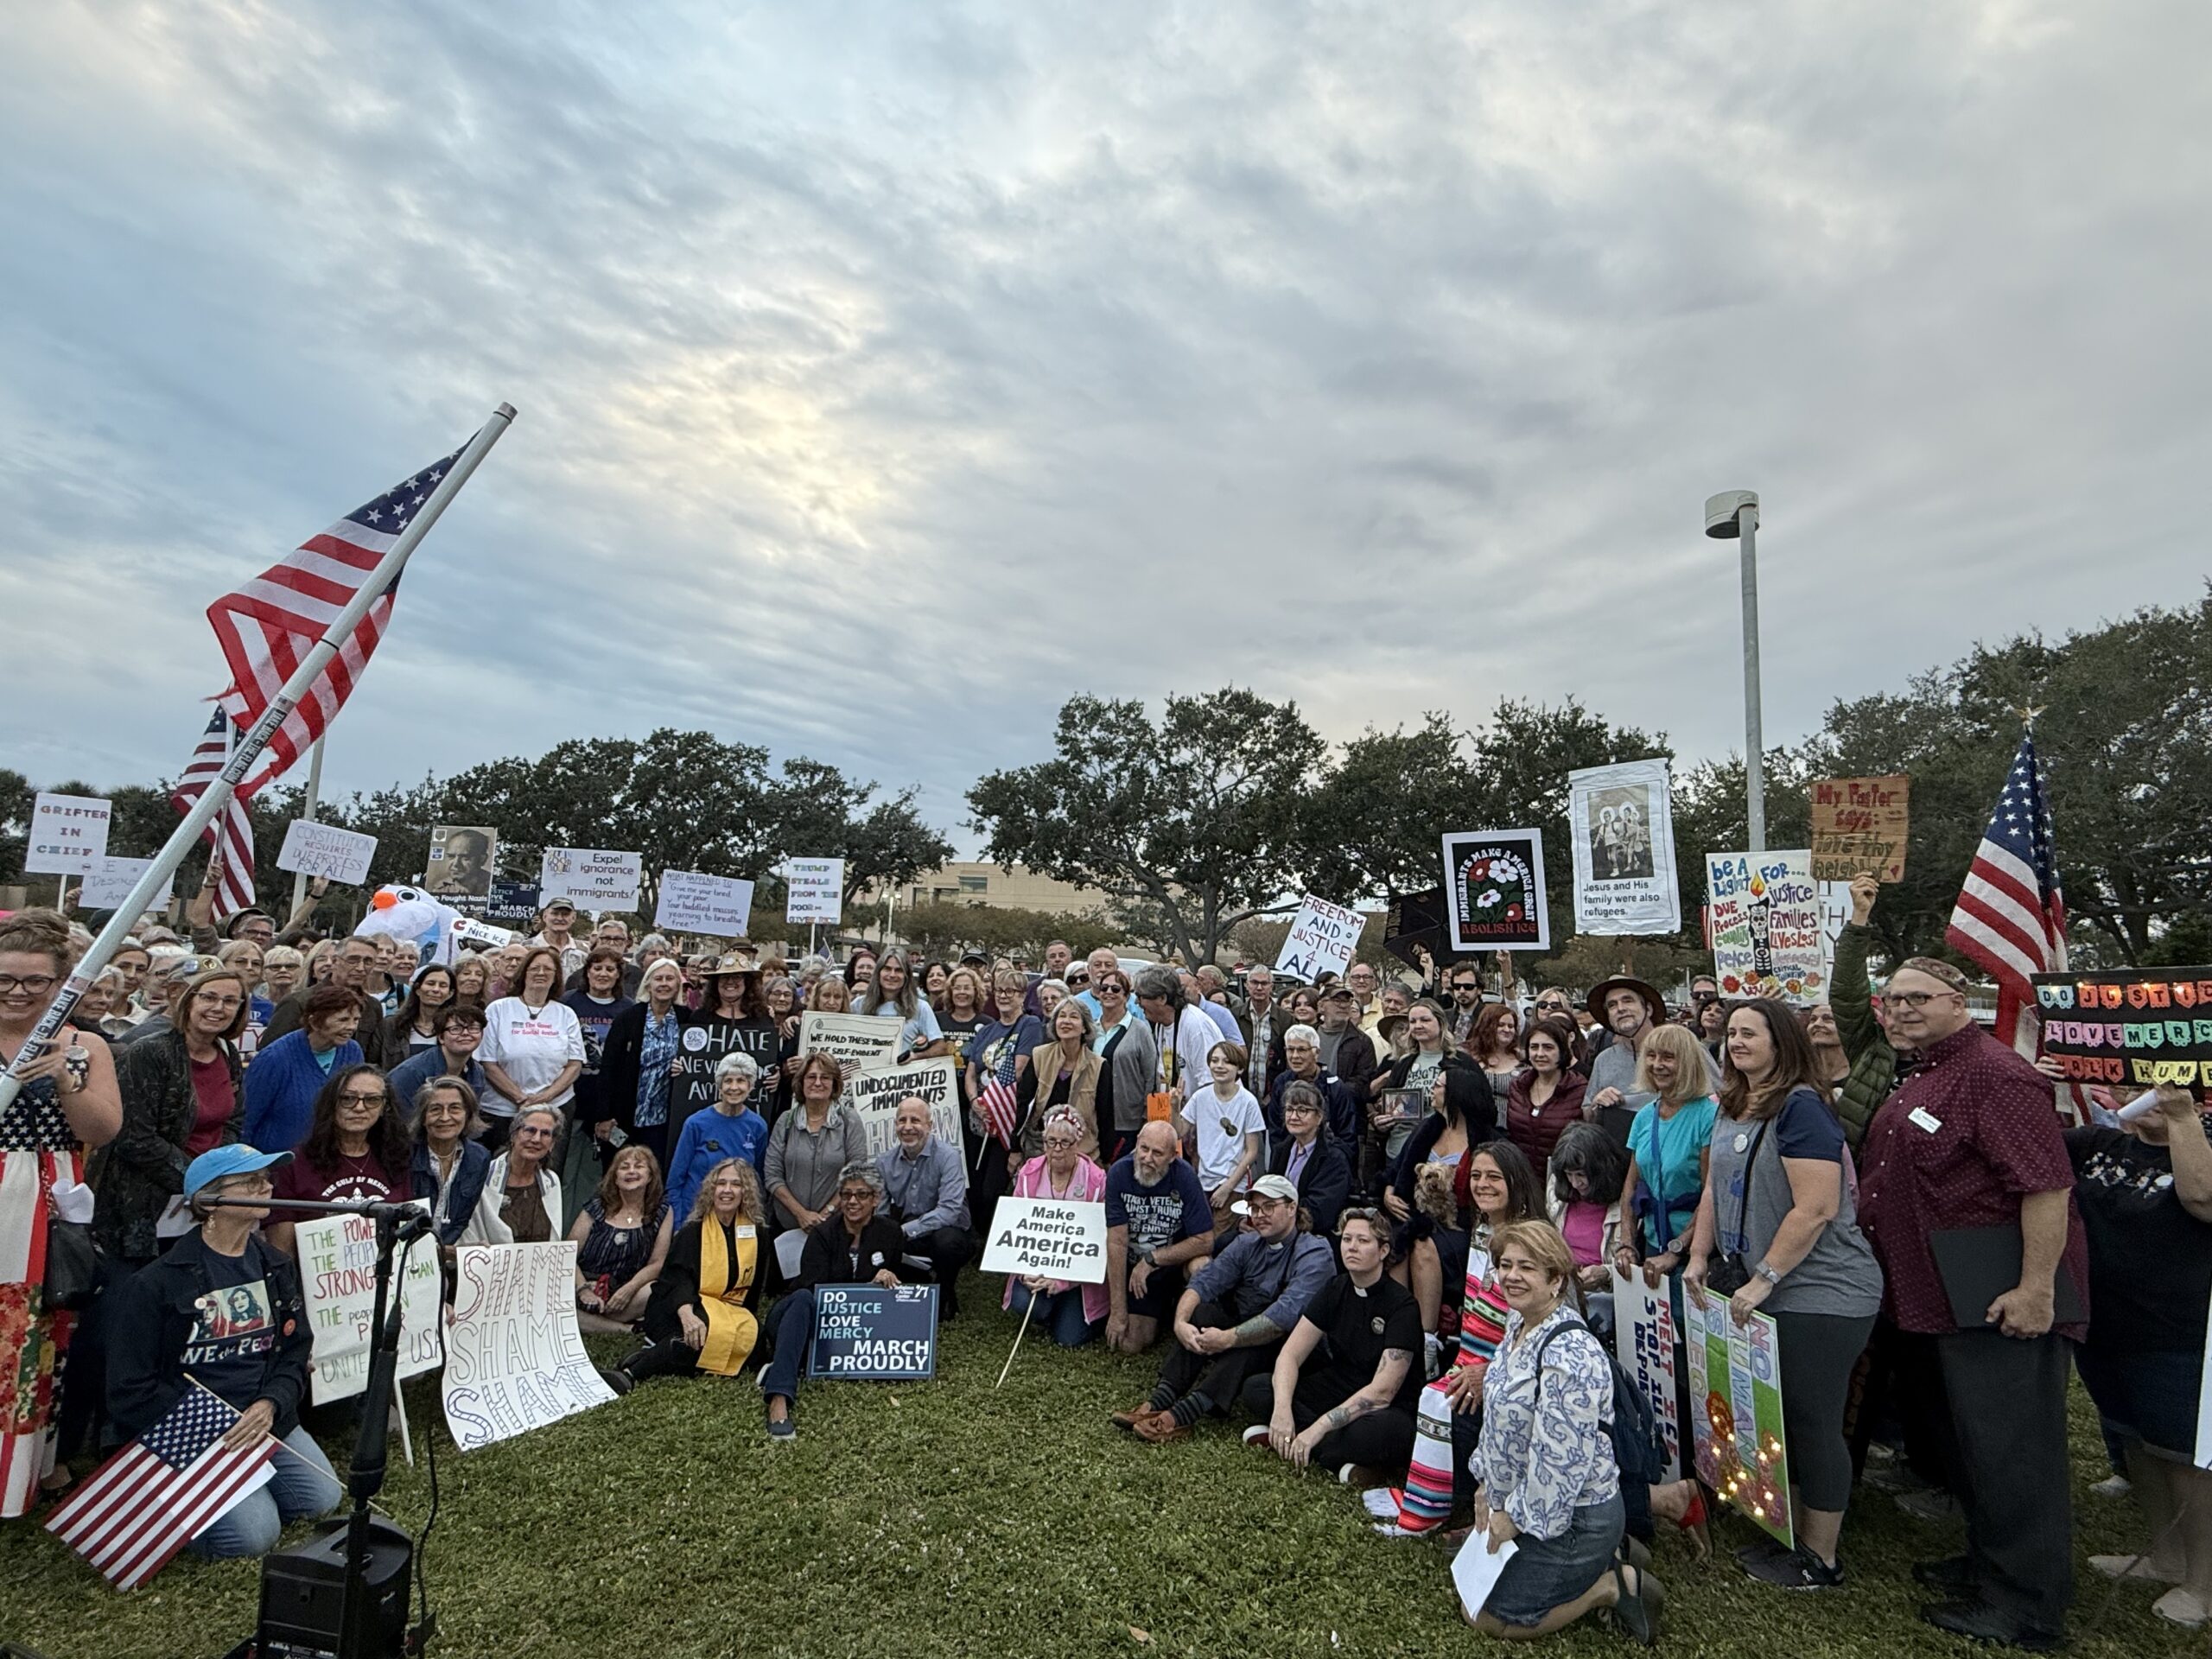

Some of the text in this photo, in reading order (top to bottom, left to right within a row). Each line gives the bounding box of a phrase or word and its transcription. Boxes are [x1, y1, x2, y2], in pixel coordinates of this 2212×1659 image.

[41, 805, 108, 820] GRIFTER
[60, 827, 81, 837] IN
[296, 825, 373, 852] CONSTITUTION
[36, 845, 92, 856] CHIEF
[292, 848, 315, 861] DUE
[305, 840, 353, 855] REQUIRES
[1471, 849, 1502, 862] MAKE
[593, 853, 622, 865] Expel
[1738, 857, 1749, 875] A
[296, 859, 346, 879] FOR ALL
[580, 863, 634, 875] ignorance
[1503, 850, 1533, 892] AMERICA
[595, 876, 614, 886] not
[666, 872, 684, 880] WHAT
[686, 875, 721, 886] HAPPENED
[1583, 880, 1649, 892] Jesus and His
[567, 887, 635, 899] immigrants!
[1457, 858, 1473, 922] IMMIGRANTS
[499, 904, 535, 912] MARCH
[1523, 893, 1535, 921] GREAT
[1584, 894, 1612, 906] family
[1639, 893, 1660, 902] also
[1713, 899, 1738, 918] DUE
[487, 910, 534, 918] PROUDLY
[1302, 895, 1364, 931] FREEDOM
[1585, 907, 1628, 918] refugees.
[467, 927, 489, 938] NICE
[1308, 916, 1341, 938] AND
[1462, 923, 1537, 934] ABOLISH ICE
[1292, 927, 1351, 962] JUSTICE
[1306, 950, 1317, 965] 4
[2044, 984, 2212, 1003] DO JUSTIC
[52, 989, 74, 1017] TAKE
[706, 1024, 772, 1052] HATE
[810, 1033, 823, 1042] WE
[824, 1033, 846, 1043] HOLD
[848, 1036, 872, 1045] THESE
[2051, 1024, 2212, 1043] LOVE MERC
[679, 1056, 721, 1074] NEVE
[855, 1069, 947, 1097] UNDOCUMENTED
[865, 1105, 962, 1159] HUAN
[321, 1184, 337, 1197] THE
[335, 1177, 354, 1187] GULF
[366, 1178, 391, 1195] MEXICO
[1032, 1206, 1076, 1221] Make
[1151, 1205, 1182, 1219] TRUMP
[306, 1217, 375, 1250] THE POWE
[1016, 1218, 1085, 1236] America
[995, 1230, 1100, 1258] America
[311, 1254, 337, 1273] THE
[343, 1242, 377, 1268] PEOPL
[1017, 1251, 1071, 1269] Again!
[456, 1245, 576, 1321] SHAME
[823, 1292, 847, 1303] DO
[316, 1306, 372, 1328] THE peop
[820, 1302, 882, 1314] JUSTICE
[1707, 1298, 1724, 1336] IS
[821, 1315, 861, 1328] LOVE
[819, 1326, 874, 1339] MERCY
[1644, 1295, 1661, 1370] STOP
[218, 1347, 236, 1360] the
[238, 1334, 275, 1355] PEO
[449, 1310, 587, 1386] SHAME
[853, 1340, 929, 1355] MARCH
[1750, 1316, 1770, 1381] NO
[321, 1351, 368, 1383] UNITE
[830, 1355, 928, 1371] PROUDLY
[1657, 1297, 1678, 1458] MELT ICE
[448, 1361, 614, 1444] SHAME
